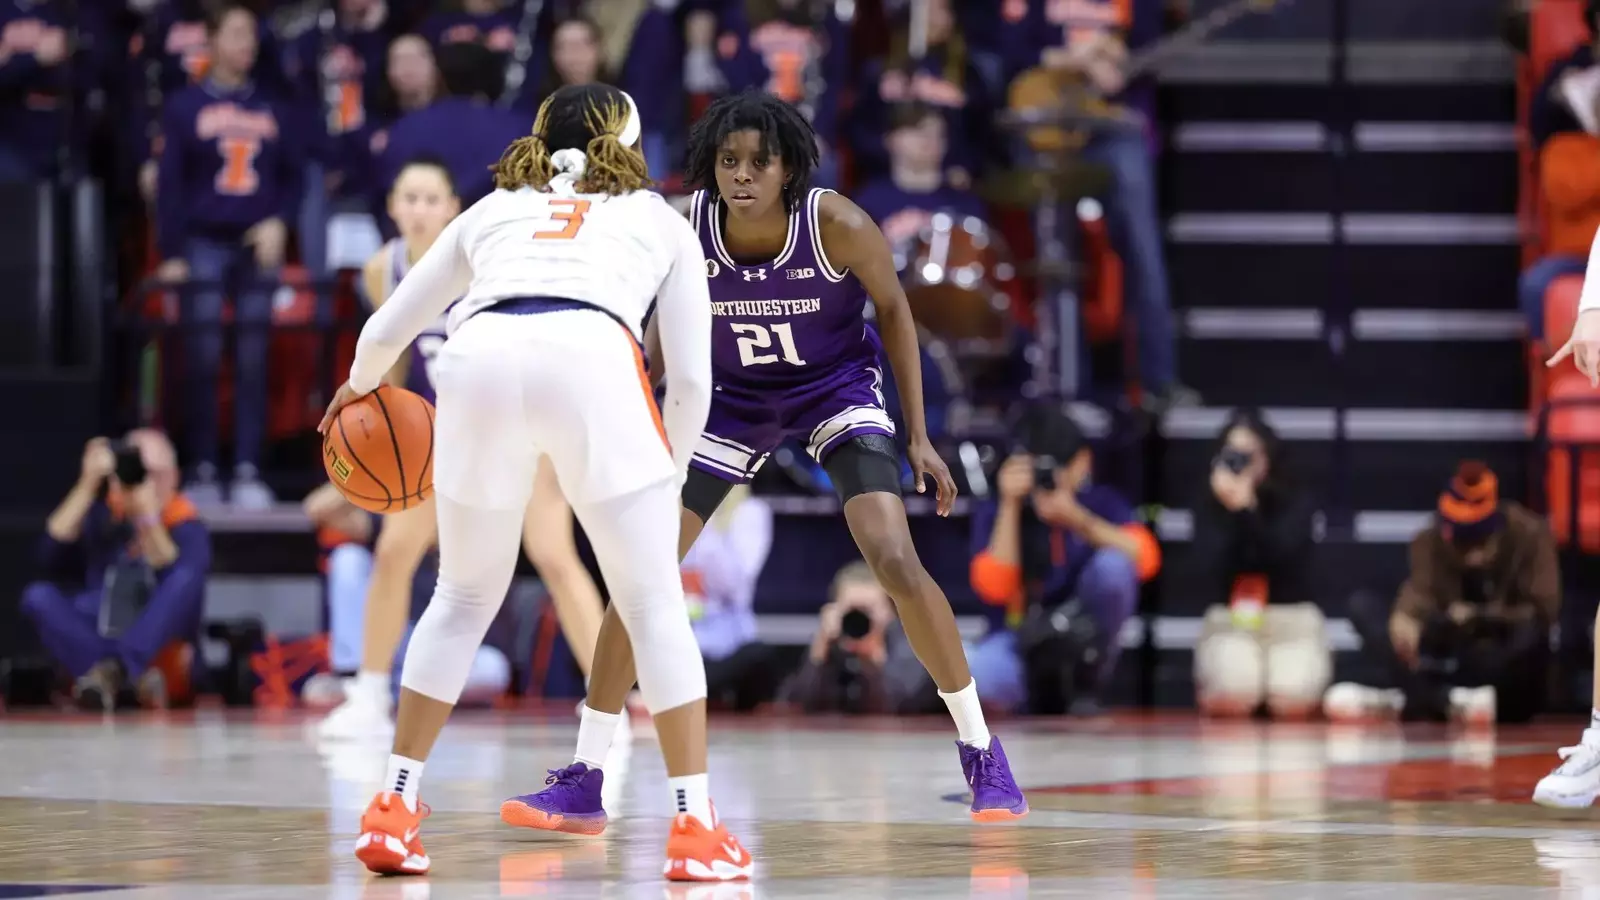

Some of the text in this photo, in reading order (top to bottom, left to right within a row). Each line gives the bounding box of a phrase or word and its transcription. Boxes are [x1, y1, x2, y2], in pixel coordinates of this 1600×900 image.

[532, 199, 592, 240] 3
[710, 298, 821, 316] ORTHWESTERN
[729, 322, 807, 367] 21
